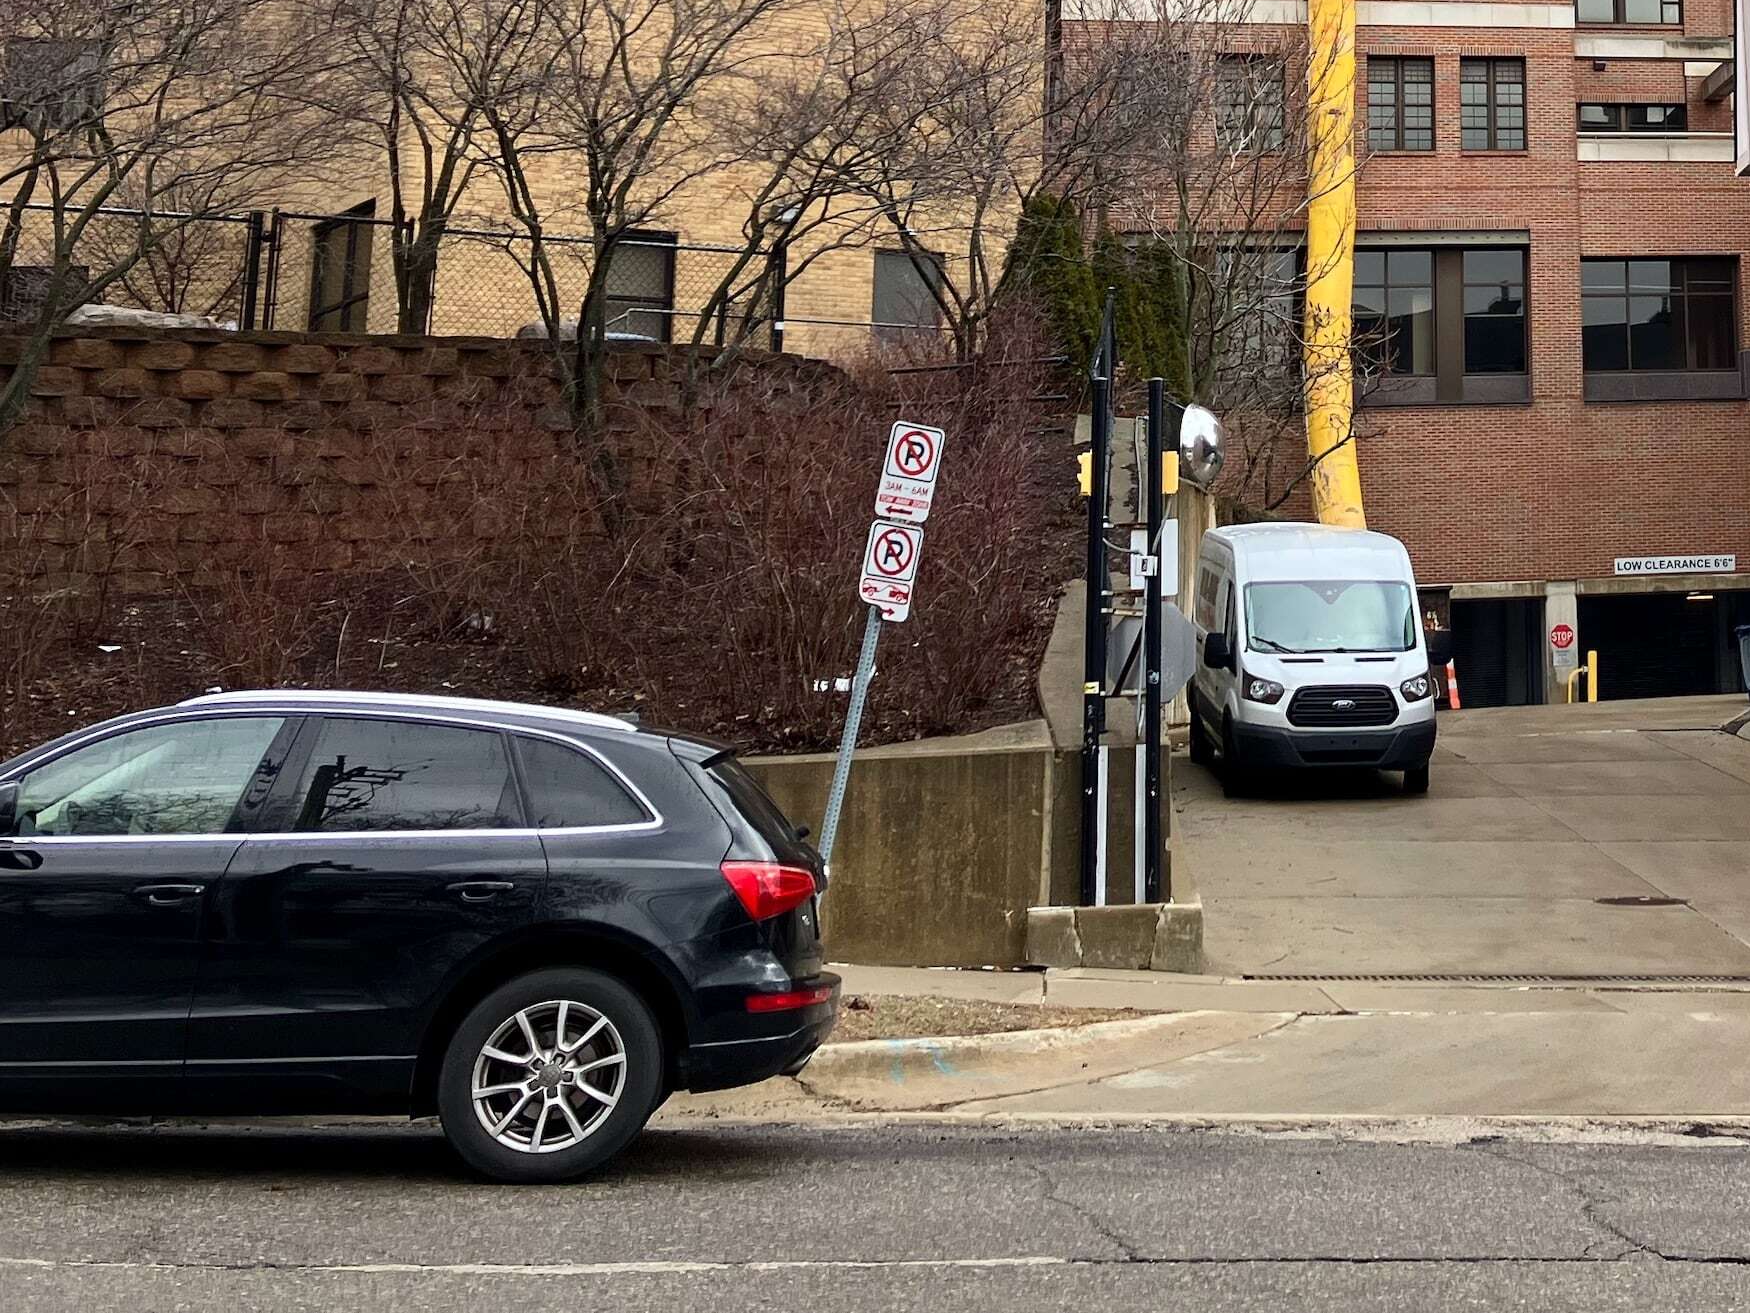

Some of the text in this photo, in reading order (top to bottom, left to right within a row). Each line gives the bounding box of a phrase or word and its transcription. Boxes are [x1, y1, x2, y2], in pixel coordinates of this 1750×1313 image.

[1617, 558, 1733, 571] LOW CLEARANCE 6'6"
[1551, 631, 1573, 642] STOP
